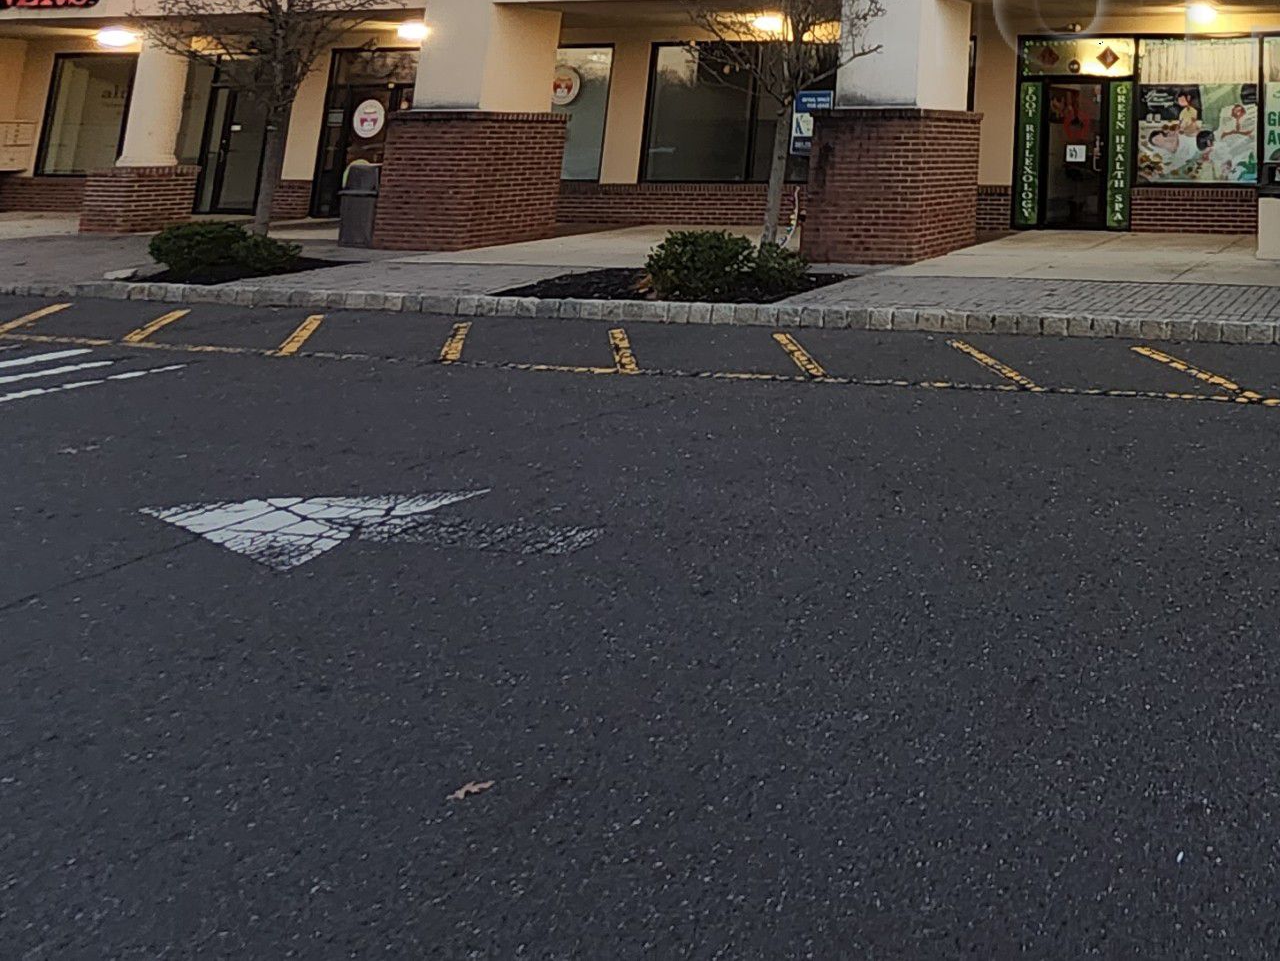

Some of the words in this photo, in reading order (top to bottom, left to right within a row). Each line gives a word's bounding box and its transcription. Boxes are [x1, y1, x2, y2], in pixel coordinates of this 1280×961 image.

[1025, 86, 1037, 118] FOOT
[1115, 85, 1127, 130] GREEN
[1021, 124, 1037, 218] REFLEXOLOGY
[1113, 134, 1126, 189] HEALTH
[1113, 194, 1124, 221] SPA
